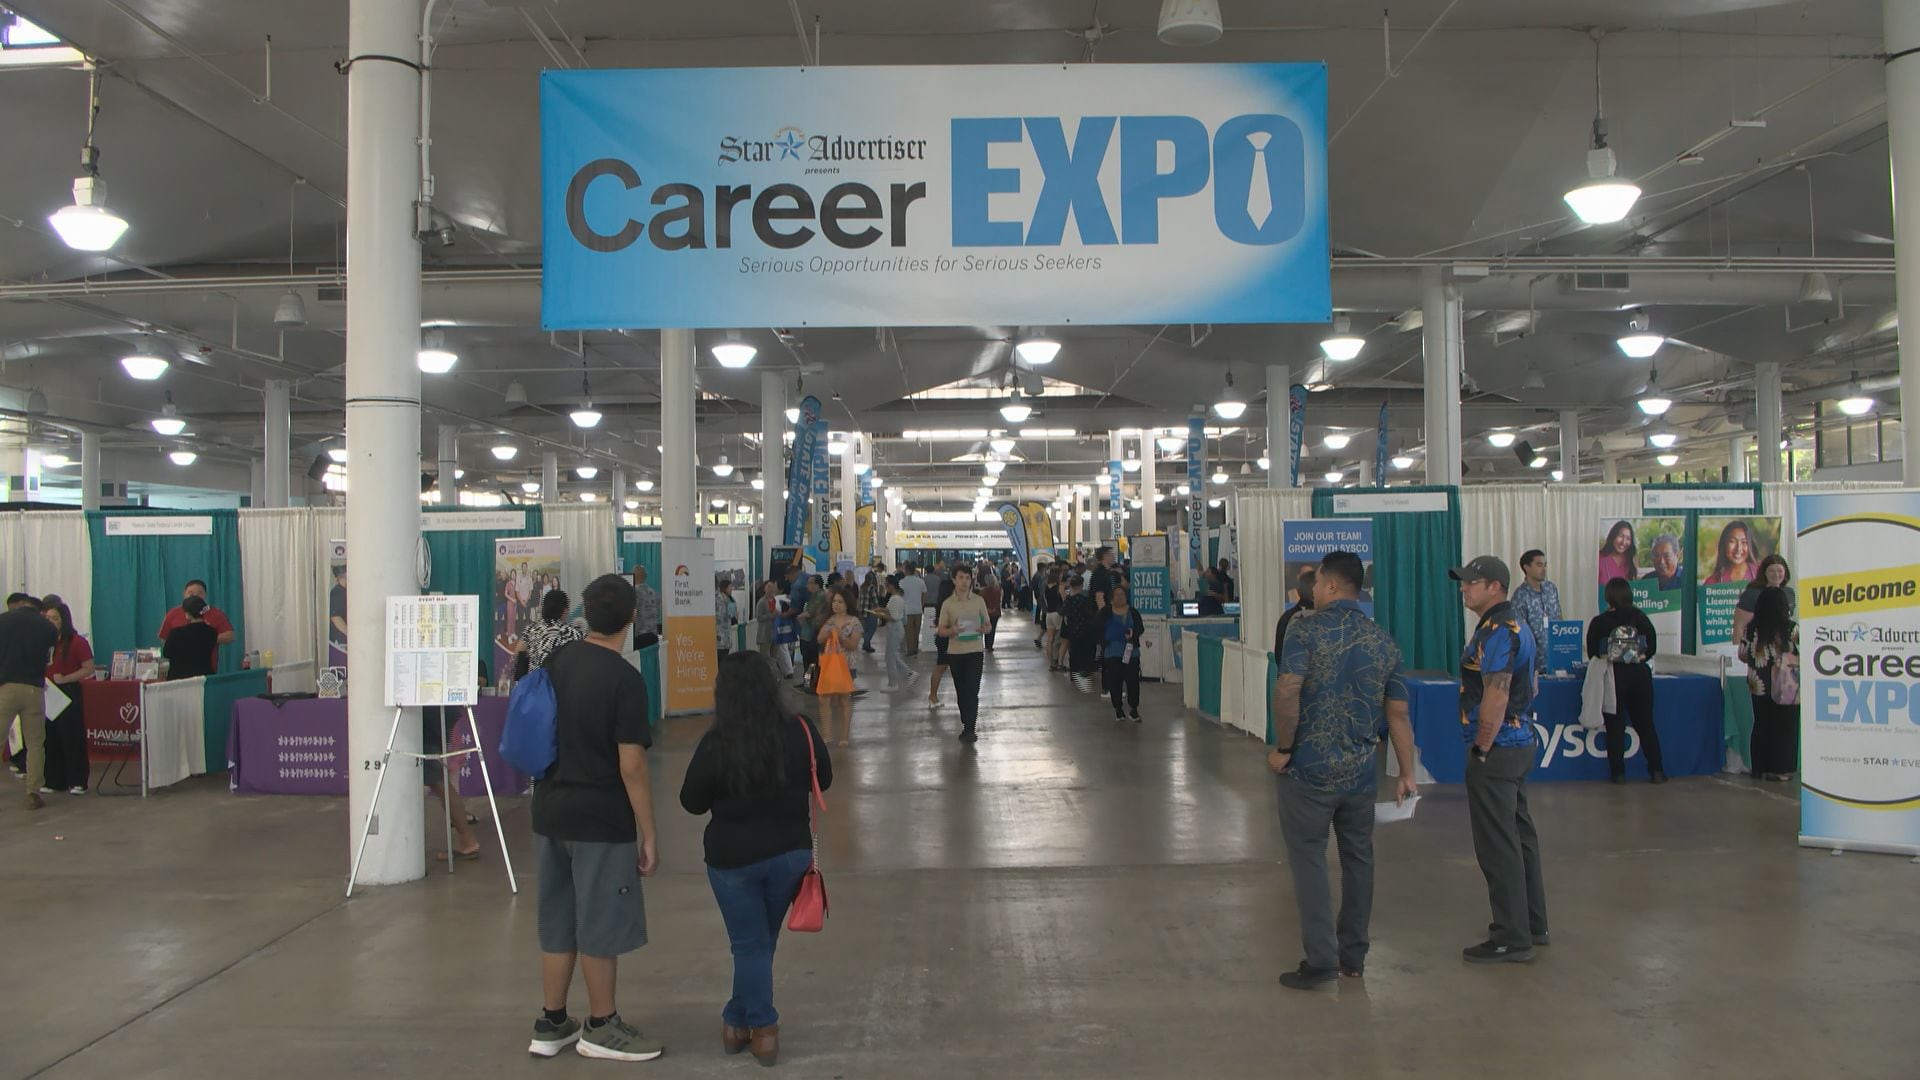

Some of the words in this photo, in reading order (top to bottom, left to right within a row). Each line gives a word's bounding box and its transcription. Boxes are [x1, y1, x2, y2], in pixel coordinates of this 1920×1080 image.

[717, 136, 774, 167] Star
[808, 134, 928, 163] Advertiser
[804, 167, 841, 176] presents
[565, 158, 926, 253] Career
[951, 113, 1305, 248] EXPO
[739, 256, 804, 274] Serious
[809, 254, 929, 277] Opportunities
[934, 254, 958, 274] for
[963, 253, 1029, 273] Serious
[1033, 252, 1102, 272] Seekers
[1188, 438, 1202, 492] EXPO
[818, 497, 831, 553] Career
[1113, 511, 1122, 541] areer
[1190, 495, 1203, 550] Career
[1294, 531, 1314, 541] JOIN
[1315, 531, 1334, 541] OUR
[1336, 531, 1362, 541] TEAM!
[1288, 544, 1316, 553] GROW
[1316, 544, 1338, 553] WITH
[1340, 543, 1369, 553] SYSCO
[674, 580, 689, 588] First
[1134, 571, 1163, 587] STATE
[674, 589, 704, 597] Hawaiian
[1705, 587, 1740, 596] Become
[1811, 579, 1916, 607] Welcome
[674, 597, 691, 605] Bank
[1134, 596, 1163, 609] OFFICE
[1705, 597, 1740, 606] License
[1705, 618, 1728, 626] while
[1552, 624, 1580, 637] Sysco
[1814, 626, 1849, 643] Star
[1869, 627, 1920, 644] Advert
[675, 633, 694, 647] Yes
[676, 648, 705, 662] We're
[1813, 644, 1920, 678] Caree
[676, 664, 708, 681] Hiring
[1820, 755, 1851, 763] POWERED
[1863, 757, 1889, 766] STAR
[1900, 758, 1920, 767] EVE
